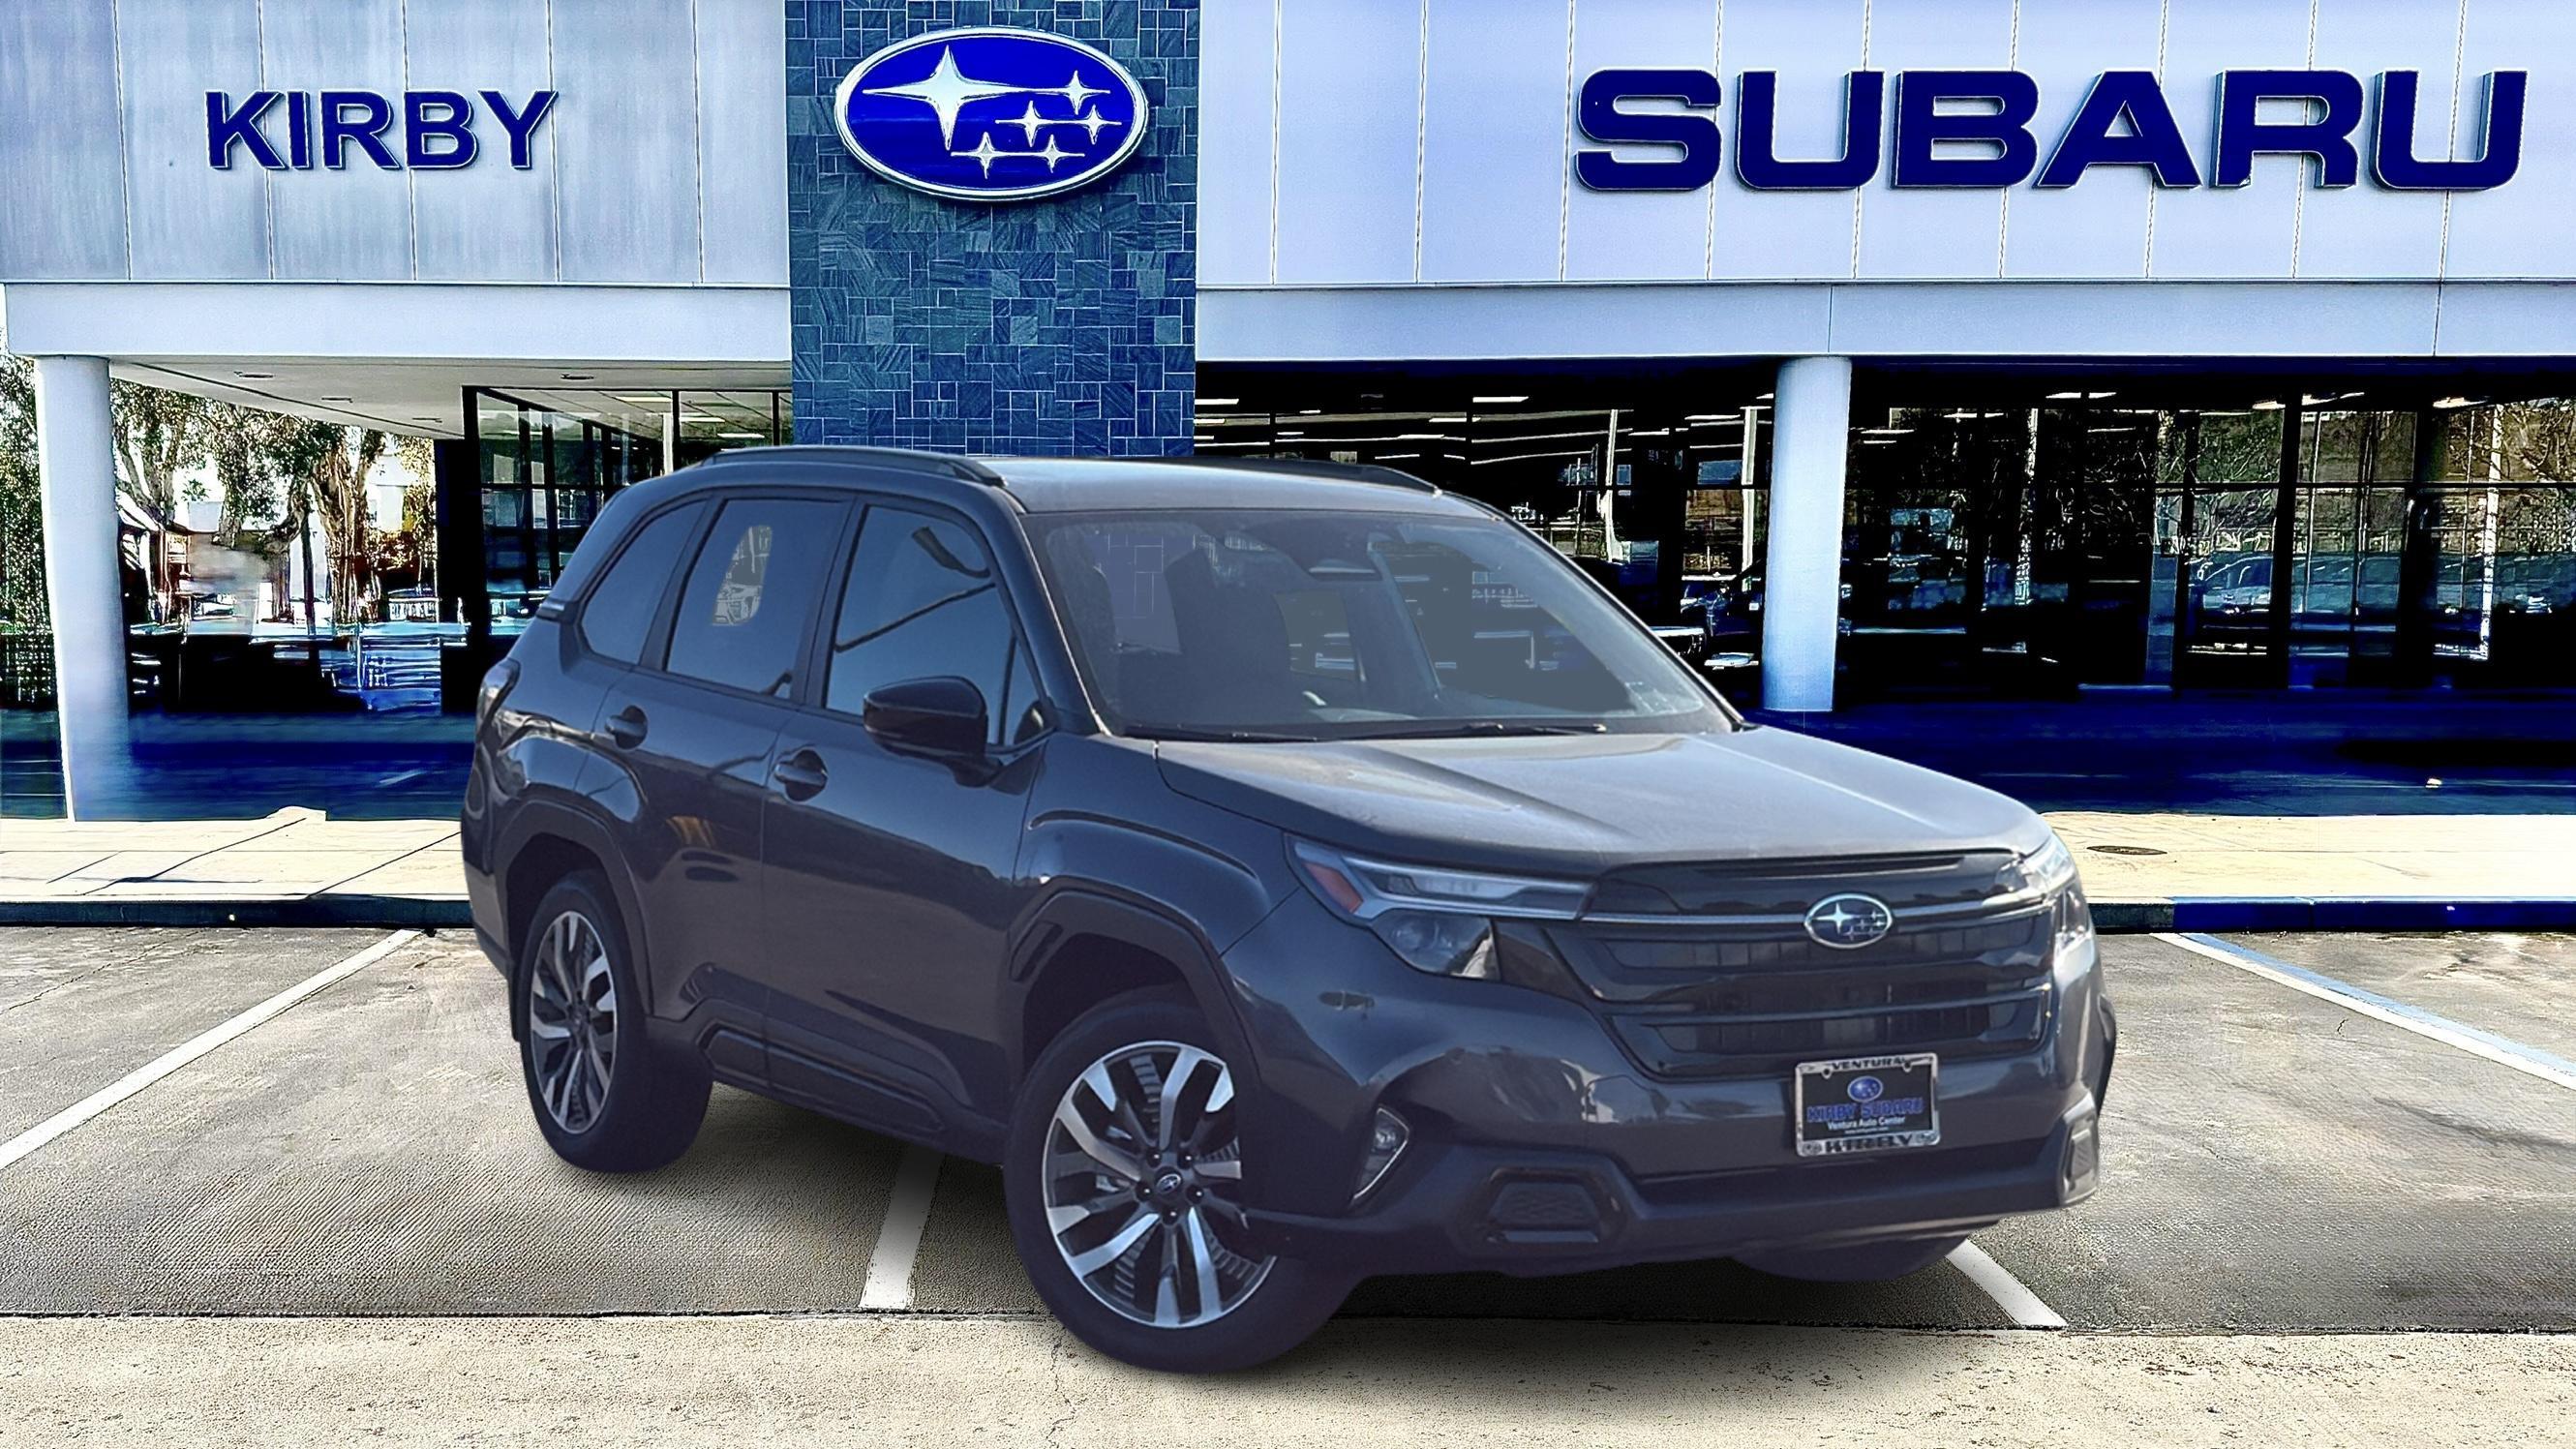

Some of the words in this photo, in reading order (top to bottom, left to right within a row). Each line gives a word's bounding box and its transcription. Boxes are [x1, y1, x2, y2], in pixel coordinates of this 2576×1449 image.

[204, 90, 559, 170] KIRBY
[1574, 70, 2528, 194] SUBARU
[1832, 1056, 1904, 1071] VENTURA
[1806, 1103, 1856, 1123] KIRBY
[1860, 1097, 1924, 1118] SUBARU
[1828, 1119, 1858, 1131] Ventura
[1858, 1117, 1877, 1127] Auto
[1878, 1115, 1906, 1126] Center
[1825, 1134, 1913, 1153] KIRBY
